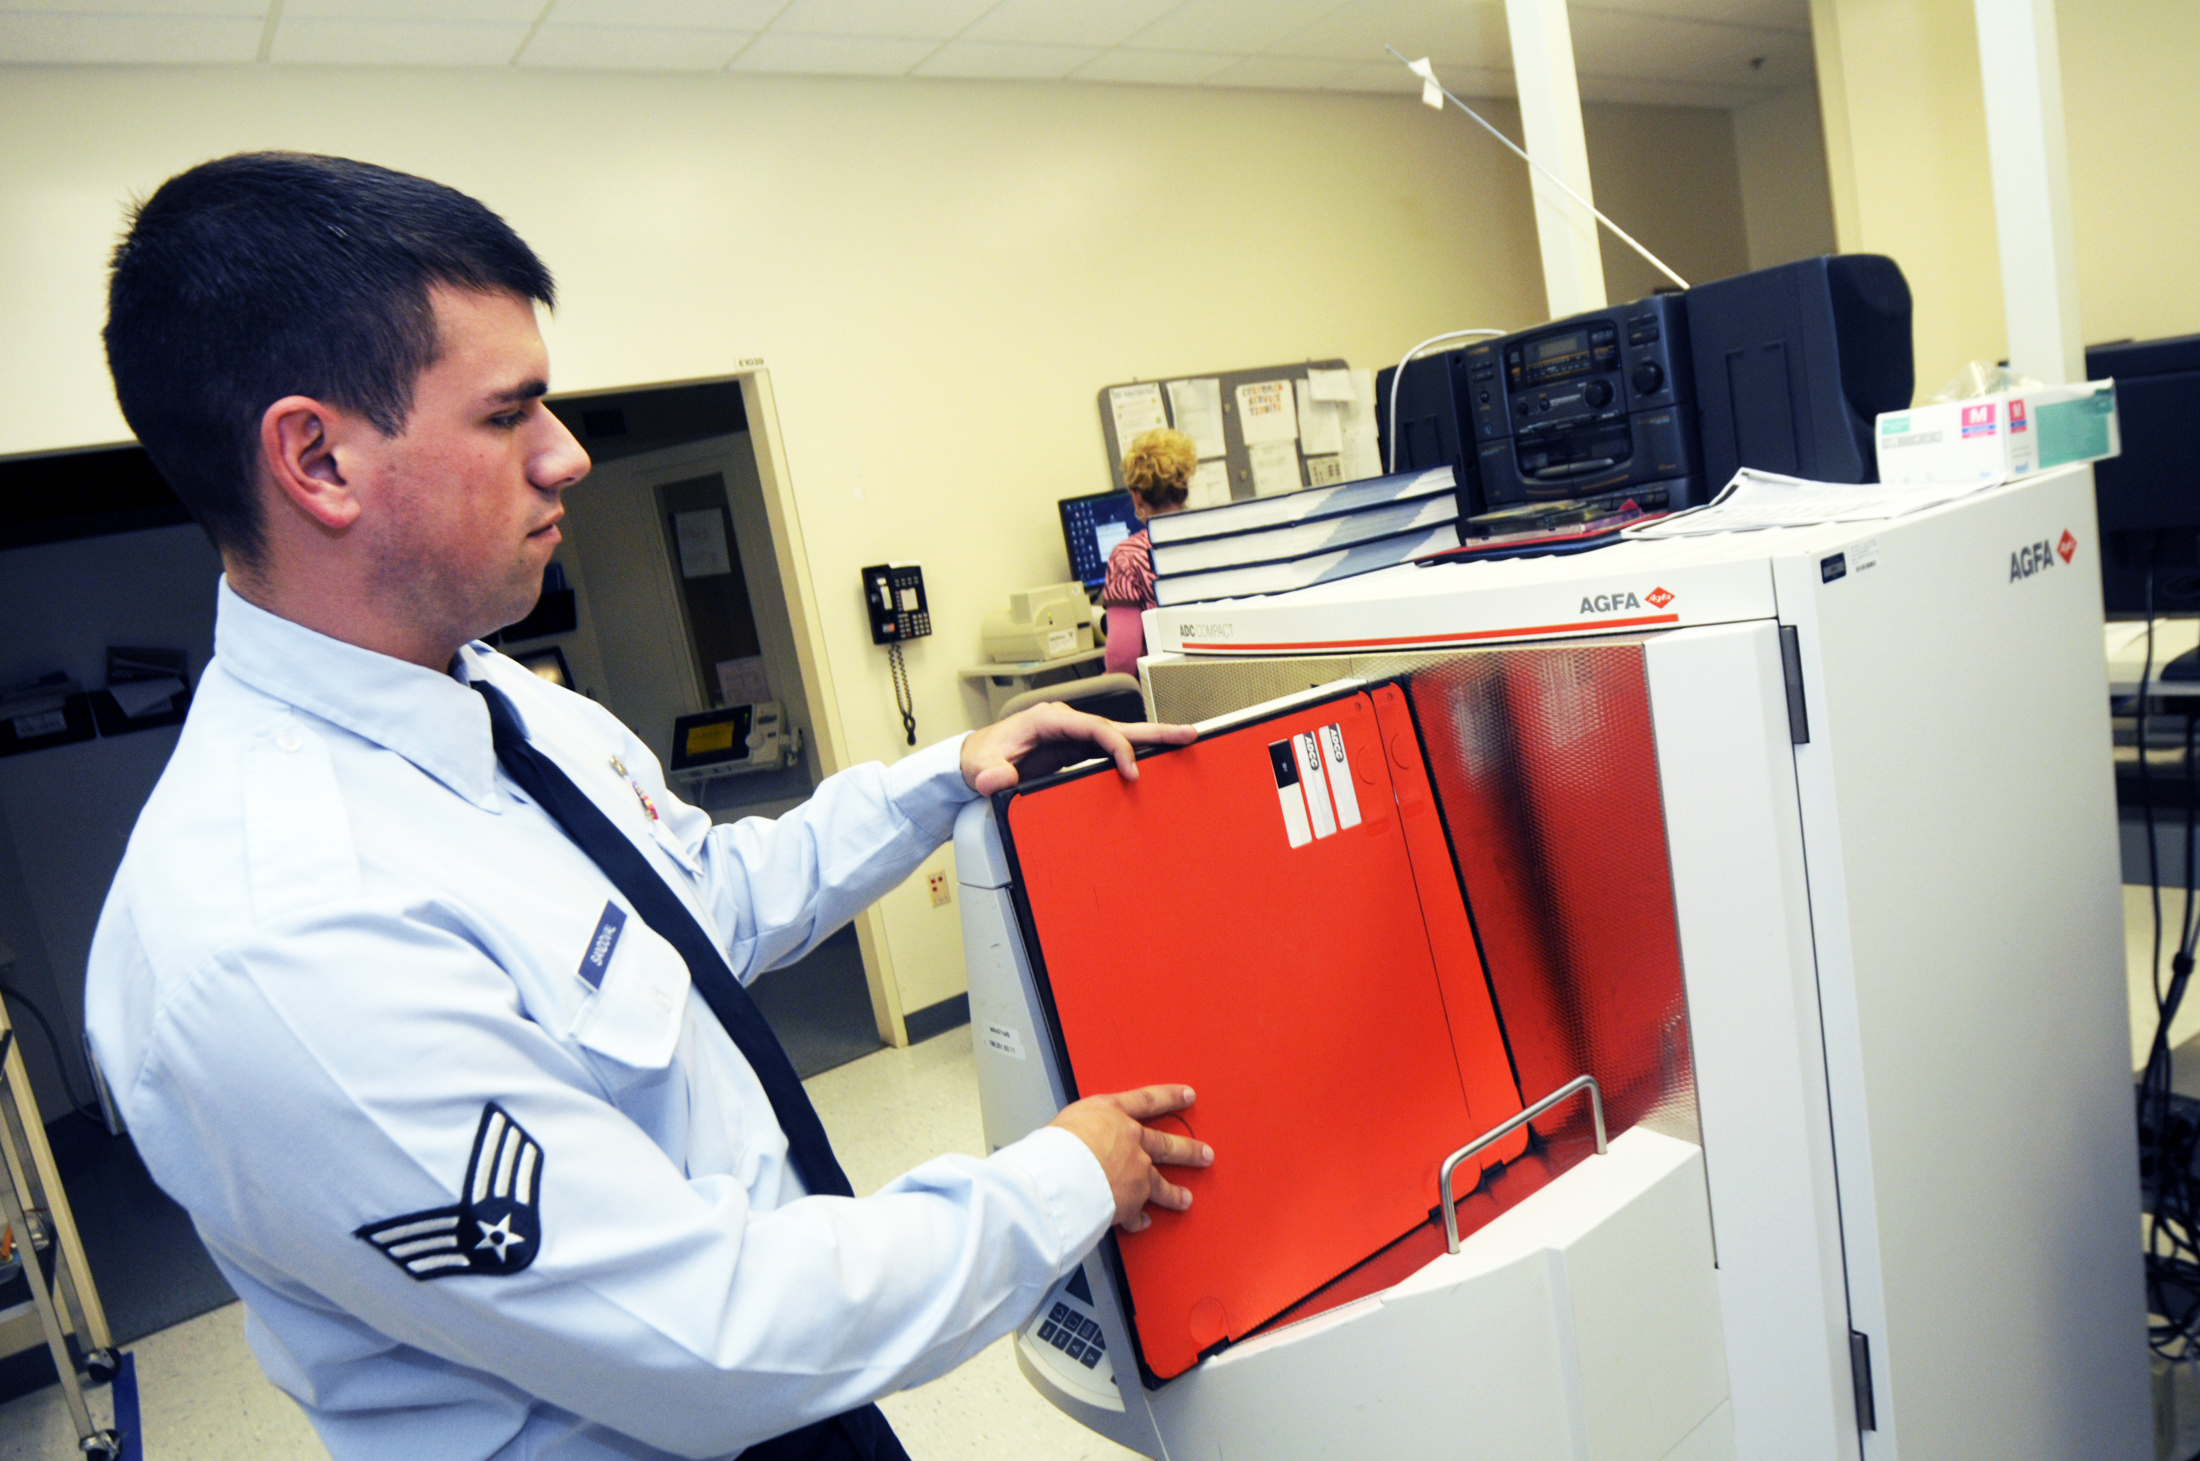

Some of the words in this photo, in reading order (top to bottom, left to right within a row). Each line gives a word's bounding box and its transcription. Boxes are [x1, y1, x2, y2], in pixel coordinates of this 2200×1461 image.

[1969, 406, 1988, 424] M
[2013, 402, 2023, 419] M
[2009, 538, 2055, 583] AGFA
[1580, 591, 1641, 614] AGFA
[1648, 592, 1672, 604] Agfa
[1180, 624, 1196, 637] ADC
[1196, 623, 1234, 638] COMPACT
[1305, 735, 1319, 768] ADCC
[1330, 728, 1344, 760] ADCC
